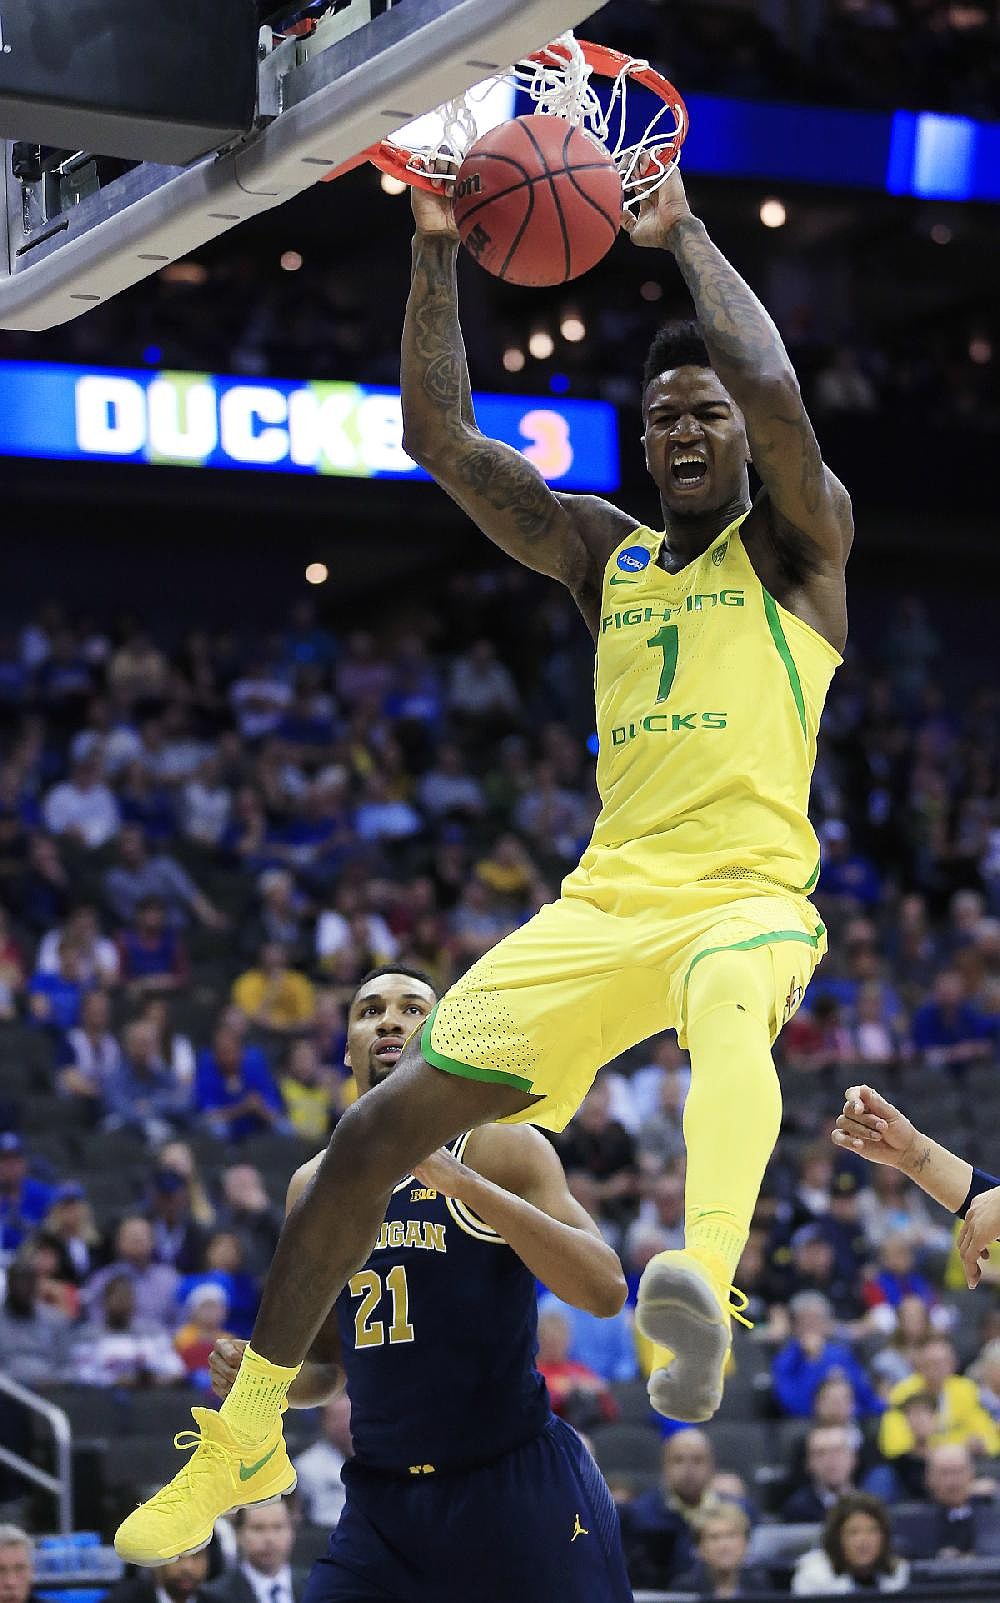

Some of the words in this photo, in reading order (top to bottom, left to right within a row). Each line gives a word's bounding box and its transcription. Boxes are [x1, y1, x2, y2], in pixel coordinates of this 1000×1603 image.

[75, 374, 417, 473] DUCKS
[646, 624, 679, 705] 1
[348, 1265, 415, 1349] 21
